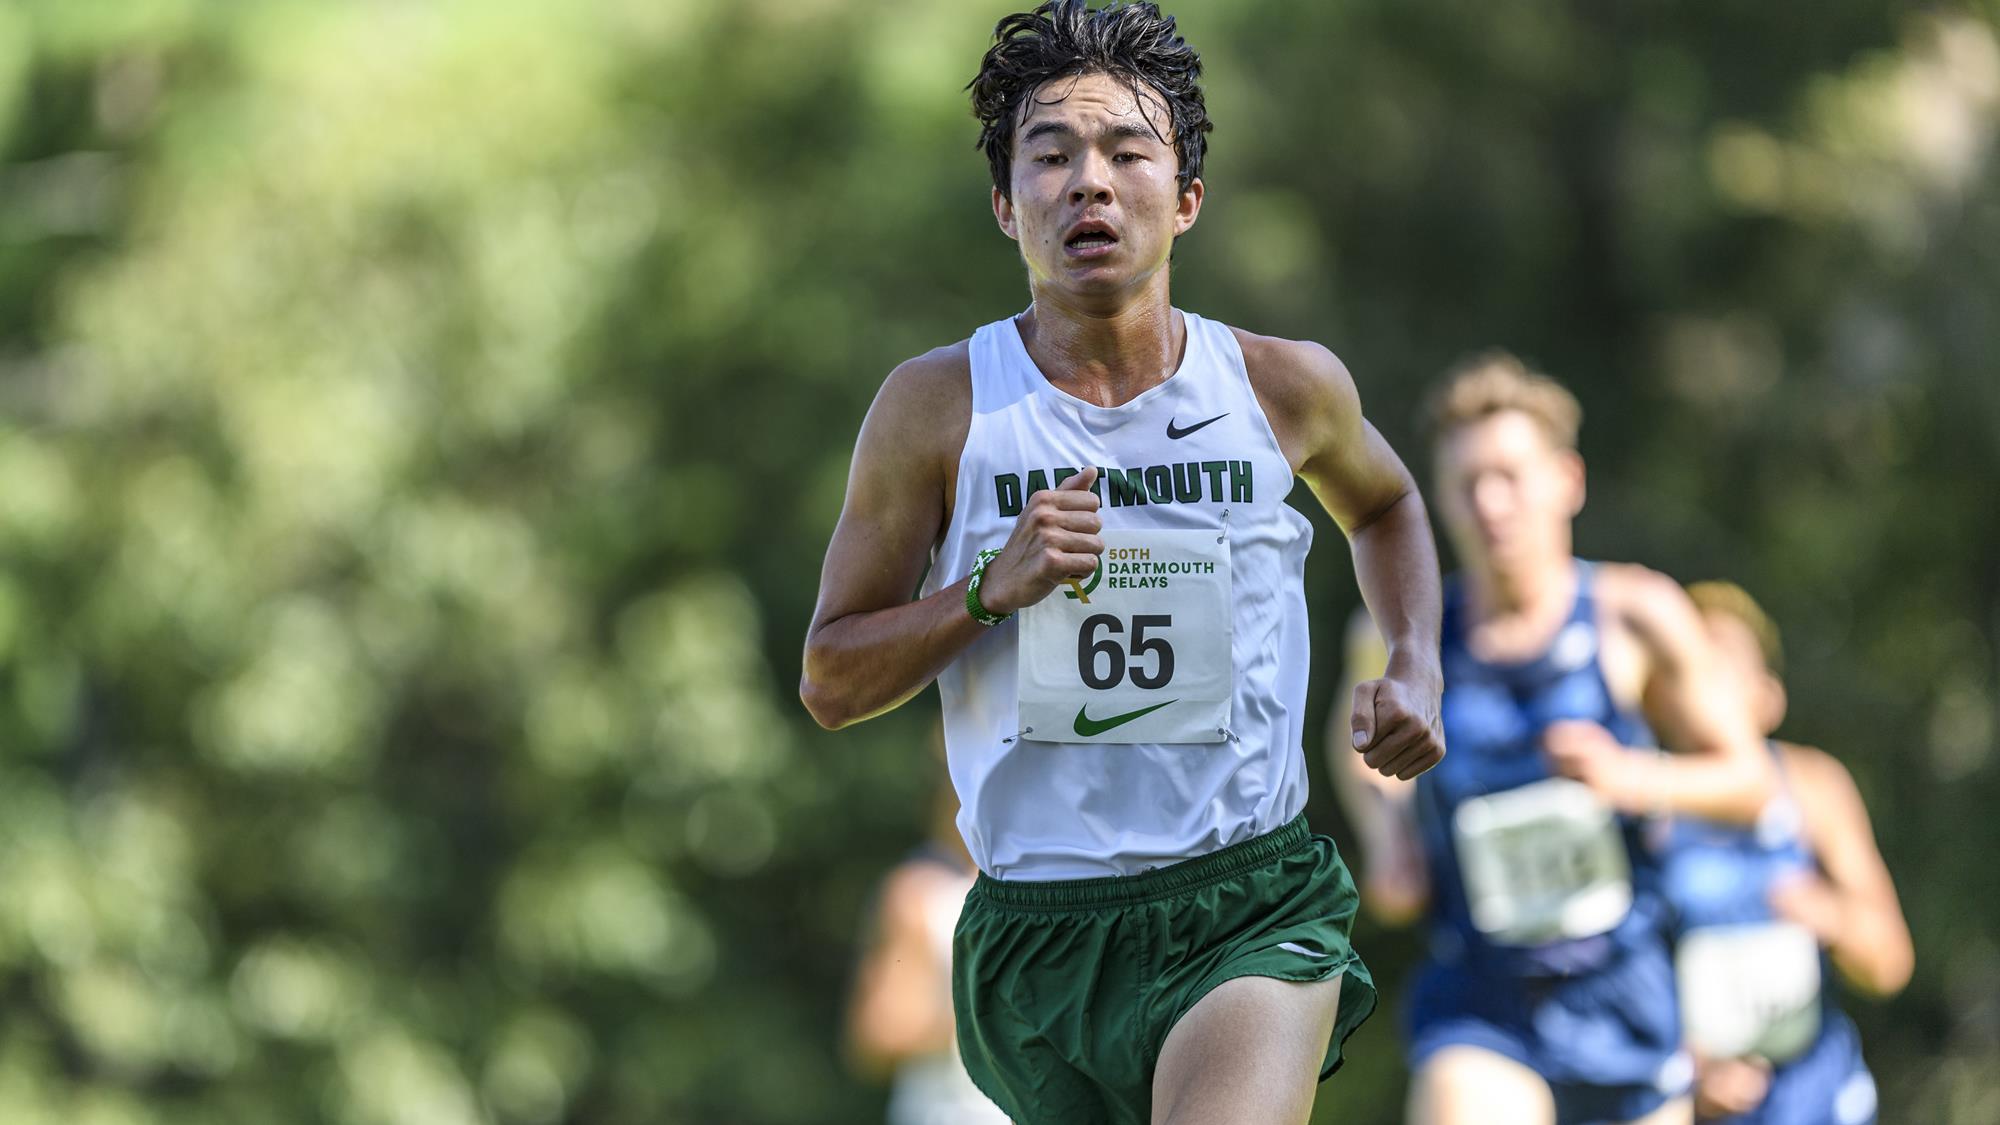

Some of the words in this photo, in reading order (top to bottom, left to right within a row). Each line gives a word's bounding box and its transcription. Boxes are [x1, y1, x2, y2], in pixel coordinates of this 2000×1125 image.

[1108, 548, 1151, 560] 50TH
[1108, 562, 1215, 574] DARTMOUTH
[1108, 576, 1169, 588] RELAYS
[1077, 613, 1175, 690] 65
